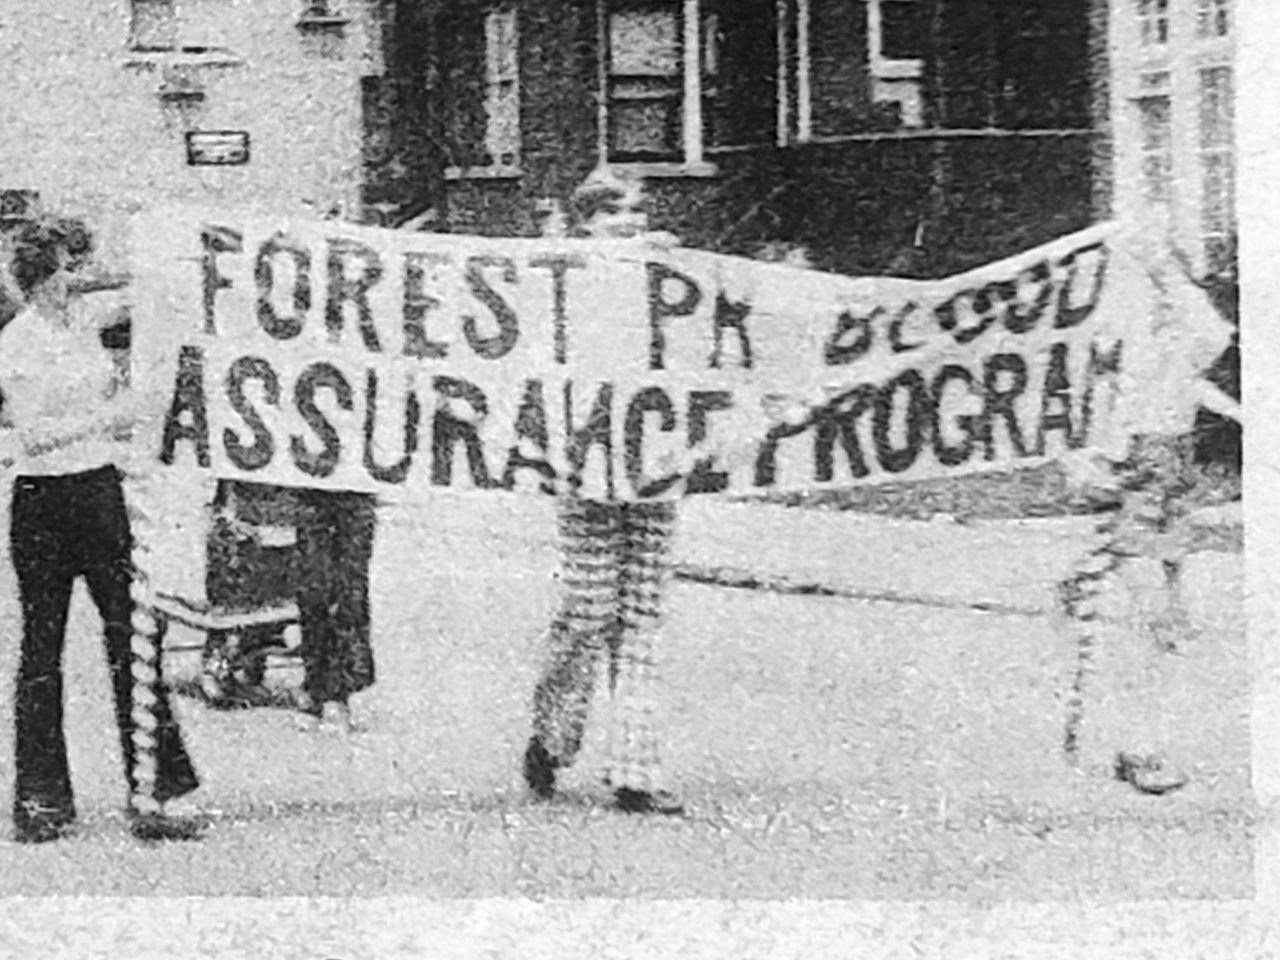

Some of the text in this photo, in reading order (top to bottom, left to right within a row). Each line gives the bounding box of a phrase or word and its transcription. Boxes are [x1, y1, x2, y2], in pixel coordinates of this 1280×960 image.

[198, 224, 587, 365] FOREST
[645, 261, 753, 371] PK
[158, 344, 733, 500] ASSURANCE
